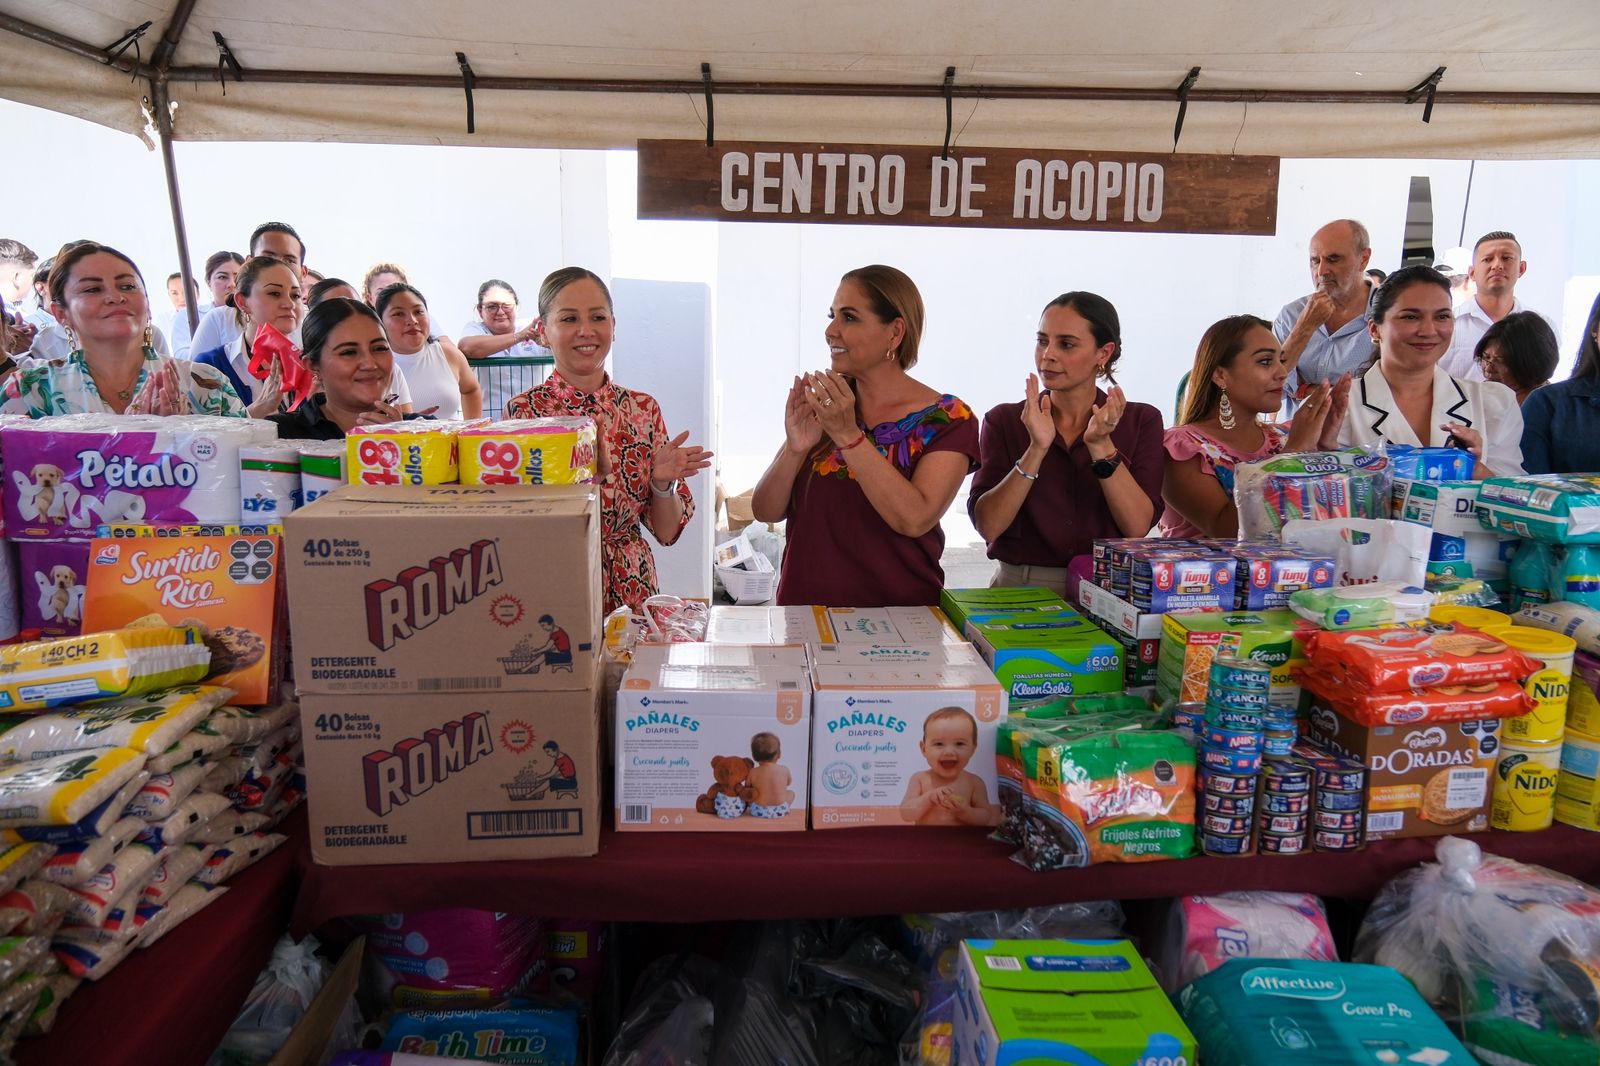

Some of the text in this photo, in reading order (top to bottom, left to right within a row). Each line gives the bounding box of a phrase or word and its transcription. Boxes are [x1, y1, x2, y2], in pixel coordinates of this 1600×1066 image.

[720, 151, 1165, 224] CENTRO DE ACOPIO
[76, 449, 198, 488] Pétalo
[405, 445, 423, 485] ollos
[526, 448, 543, 485] ollos
[303, 539, 331, 558] 40
[333, 539, 359, 547] Bolsas
[334, 549, 370, 558] de 250 g
[121, 545, 221, 585] Surtido
[1160, 567, 1169, 581] 8
[1184, 569, 1210, 584] Tuny
[1257, 567, 1267, 581] 8
[1282, 569, 1308, 584] Tuny
[156, 575, 213, 609] Rico
[364, 539, 503, 652] ROMA
[49, 643, 99, 658] 40 CH 2
[1145, 643, 1153, 656] 8
[1250, 650, 1288, 661] Knorr
[311, 657, 377, 667] DETERGENTE
[1092, 656, 1119, 666] 600
[312, 668, 396, 679] BIODEGRADABLE
[1271, 674, 1295, 684] SOP
[1012, 681, 1073, 696] KleenBebé
[344, 713, 370, 722] Bolsas
[785, 704, 794, 720] 3
[983, 702, 992, 718] 3
[315, 713, 343, 732] 40
[345, 723, 381, 733] de 250 g
[625, 711, 700, 732] PAÑALES
[826, 710, 907, 734] PAÑALES
[835, 741, 872, 753] Creciendo
[362, 711, 494, 818] ROMA
[1044, 761, 1052, 776] 6
[1371, 748, 1474, 774] DORADAS
[1040, 776, 1058, 787] PACK
[1209, 775, 1232, 790] Tuny
[822, 813, 839, 823] 80
[324, 825, 389, 835] DETERGENTE
[1103, 826, 1181, 843] Frijoles Refritos
[325, 835, 408, 848] BIODEGRADABLE
[1124, 841, 1160, 854] Negros
[1250, 975, 1336, 991] Affective
[1342, 1002, 1412, 1018] Cover Pro
[400, 1029, 546, 1057] Bath Time
